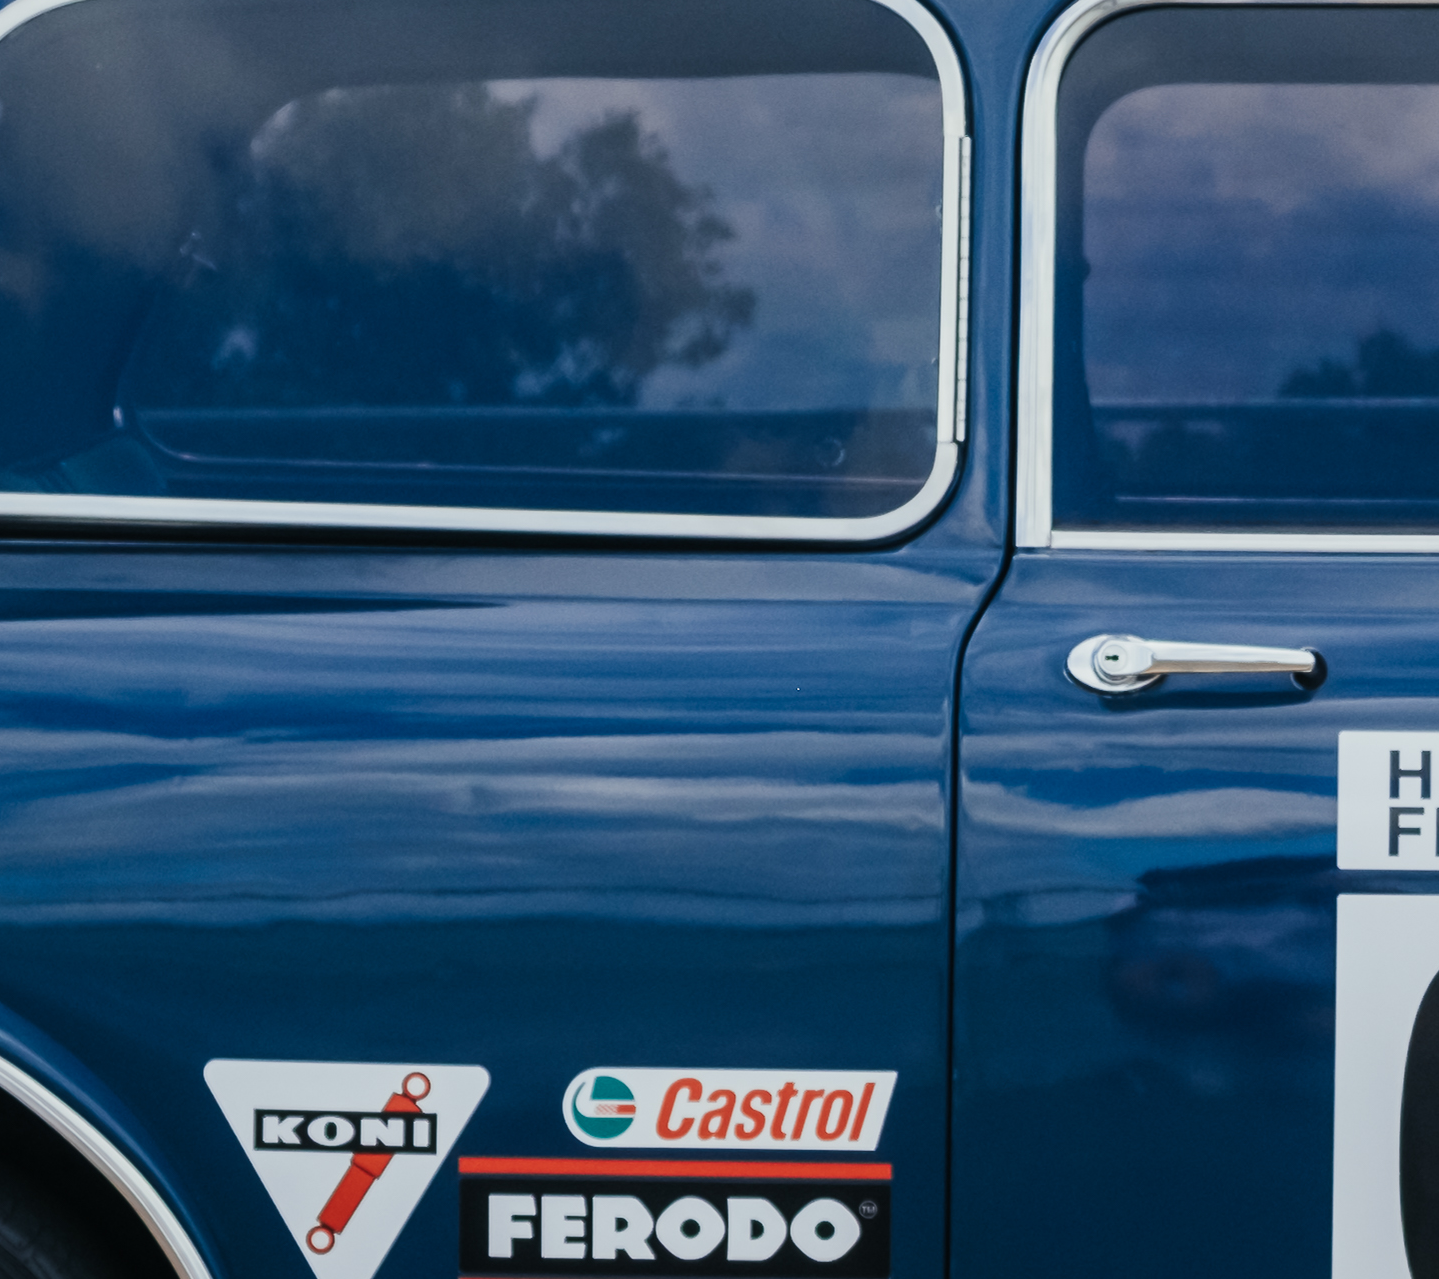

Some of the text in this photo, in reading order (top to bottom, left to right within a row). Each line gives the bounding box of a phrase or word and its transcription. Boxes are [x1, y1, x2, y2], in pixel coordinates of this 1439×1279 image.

[261, 1114, 436, 1149] KONI
[655, 1077, 875, 1141] Castrol
[487, 1193, 861, 1263] FERODO
